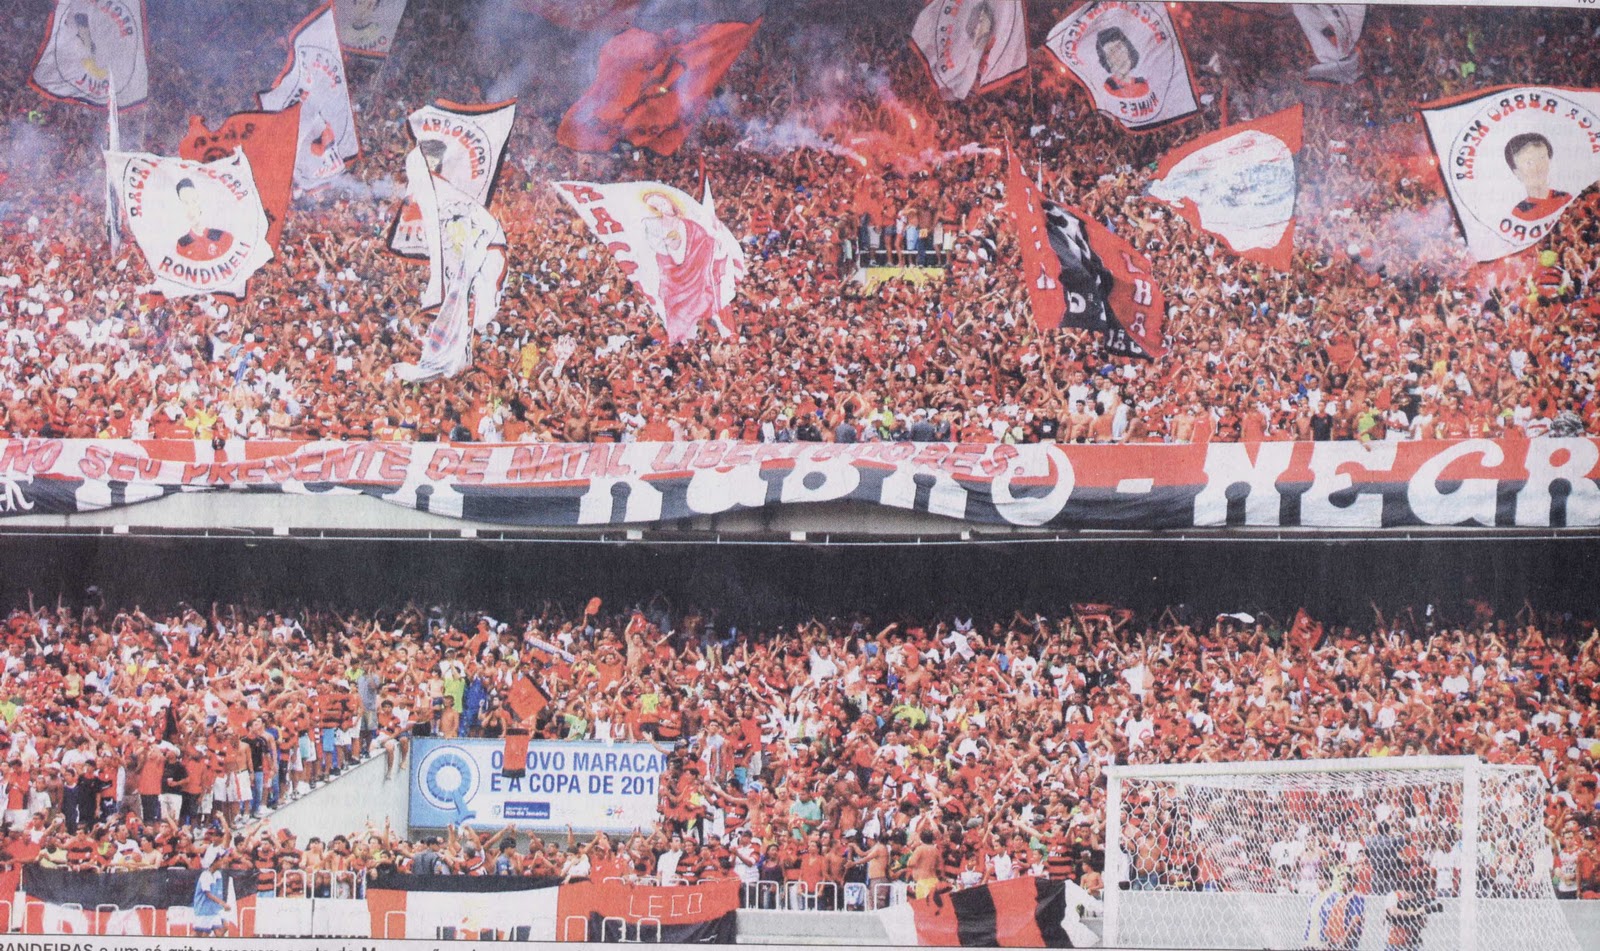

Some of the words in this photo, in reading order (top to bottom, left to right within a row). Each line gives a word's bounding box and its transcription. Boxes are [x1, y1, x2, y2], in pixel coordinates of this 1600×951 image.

[158, 241, 251, 285] RONDINELI
[0, 438, 63, 473] NO
[78, 445, 162, 480] SEU
[180, 441, 413, 484] PRESENTE
[425, 447, 493, 482] DE
[506, 443, 631, 480] NATAL
[491, 750, 503, 769] O
[526, 751, 565, 771] OVO
[491, 774, 501, 792] E
[508, 777, 521, 792] A
[529, 774, 581, 793] COPA
[588, 776, 613, 794] DE
